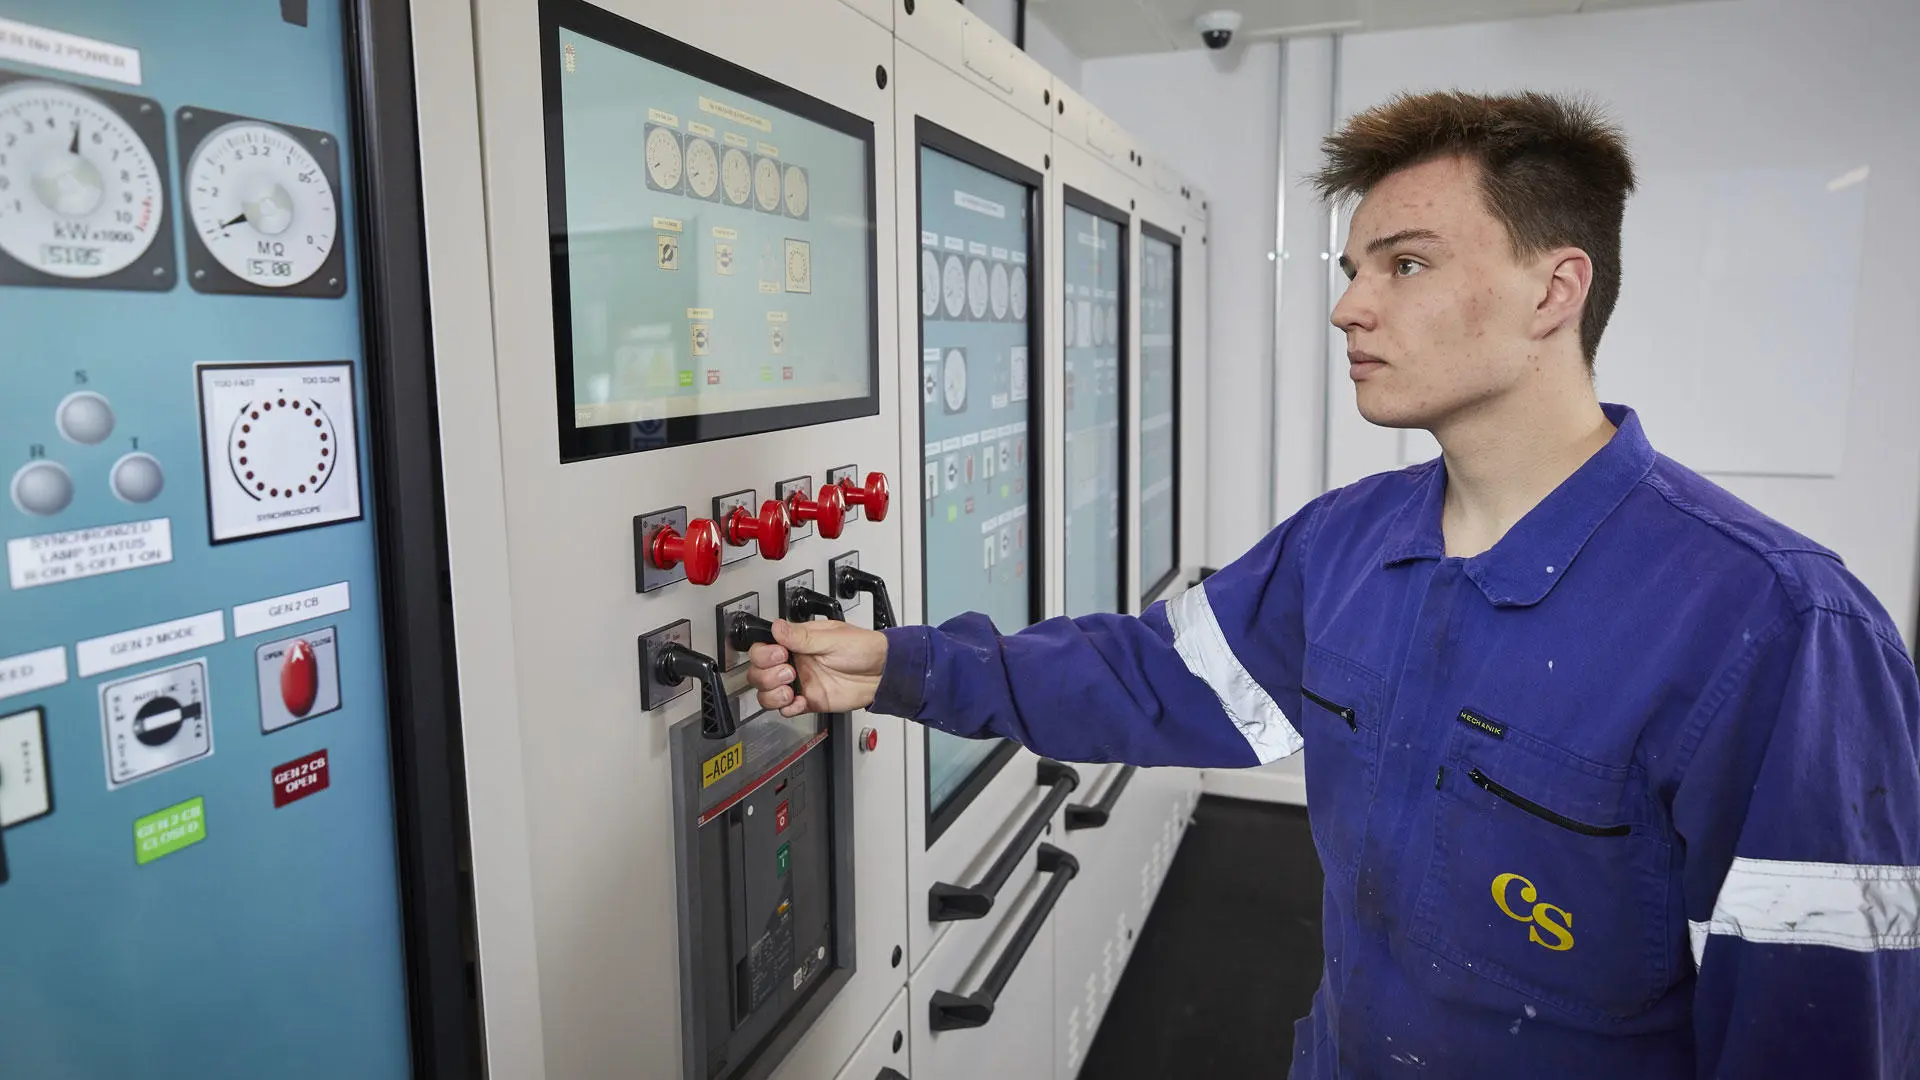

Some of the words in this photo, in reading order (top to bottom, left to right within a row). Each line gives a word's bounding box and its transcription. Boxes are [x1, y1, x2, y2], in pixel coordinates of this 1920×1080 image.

[53, 222, 89, 241] kW
[302, 377, 318, 385] TOO
[320, 376, 341, 384] SLOW
[257, 506, 321, 522] SYNCHROSCOPE
[40, 548, 85, 564] LAMP
[89, 538, 146, 554] STATUS
[269, 603, 294, 617] GEN
[303, 597, 319, 609] CB
[110, 639, 142, 655] GEN
[156, 625, 196, 644] MODE
[310, 636, 332, 648] CLOSE
[263, 651, 284, 661] OPEN
[1460, 712, 1502, 735] MECHANIK
[274, 768, 300, 785] GEN
[301, 763, 309, 775] 2
[309, 757, 326, 770] CB
[285, 773, 318, 793] OPEN
[137, 818, 169, 838] GEN
[181, 806, 201, 822] CB
[142, 821, 199, 851] CLOSED
[1491, 872, 1575, 952] CS
